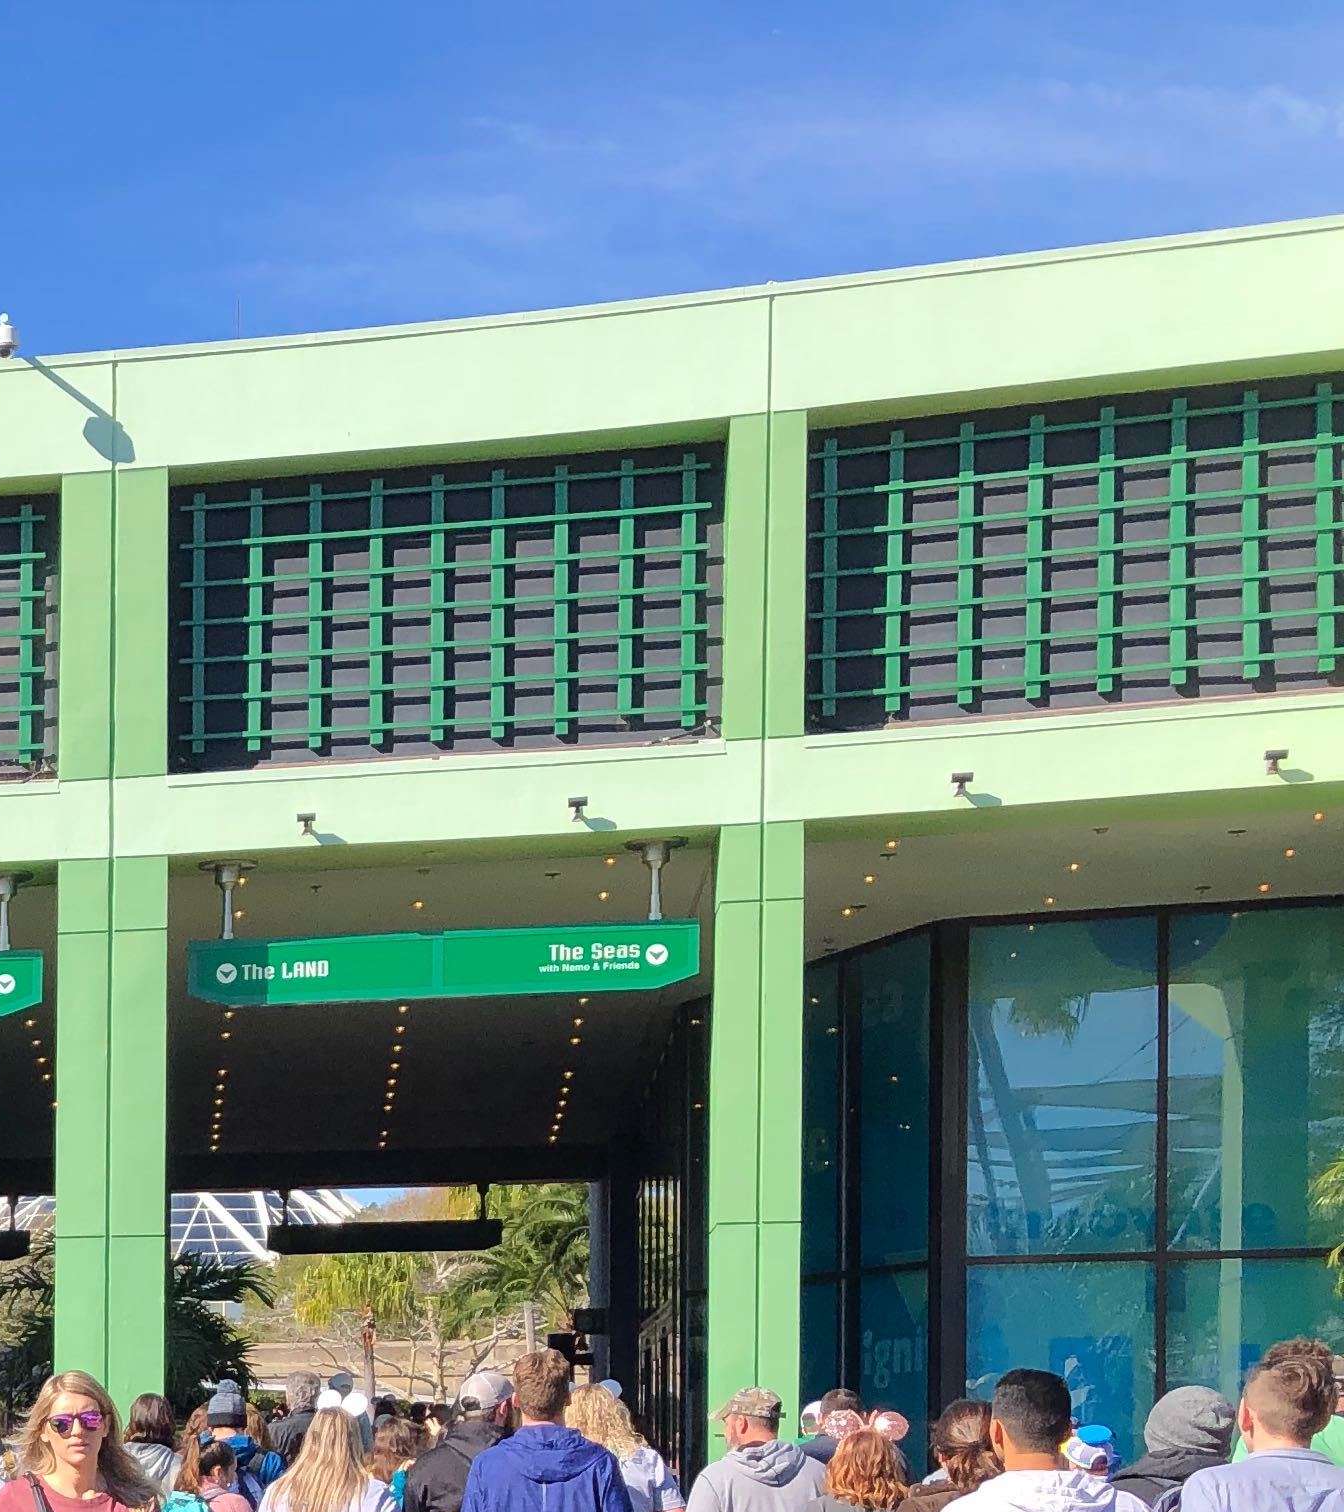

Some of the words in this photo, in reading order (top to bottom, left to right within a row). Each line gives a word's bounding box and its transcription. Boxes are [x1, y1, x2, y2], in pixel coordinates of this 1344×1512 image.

[549, 943, 584, 961] The
[591, 942, 641, 960] Seas
[241, 963, 275, 981] The
[281, 960, 330, 979] LAND
[538, 964, 560, 973] with
[561, 963, 591, 972] Nemo
[592, 962, 601, 971] &
[602, 961, 641, 971] Friends
